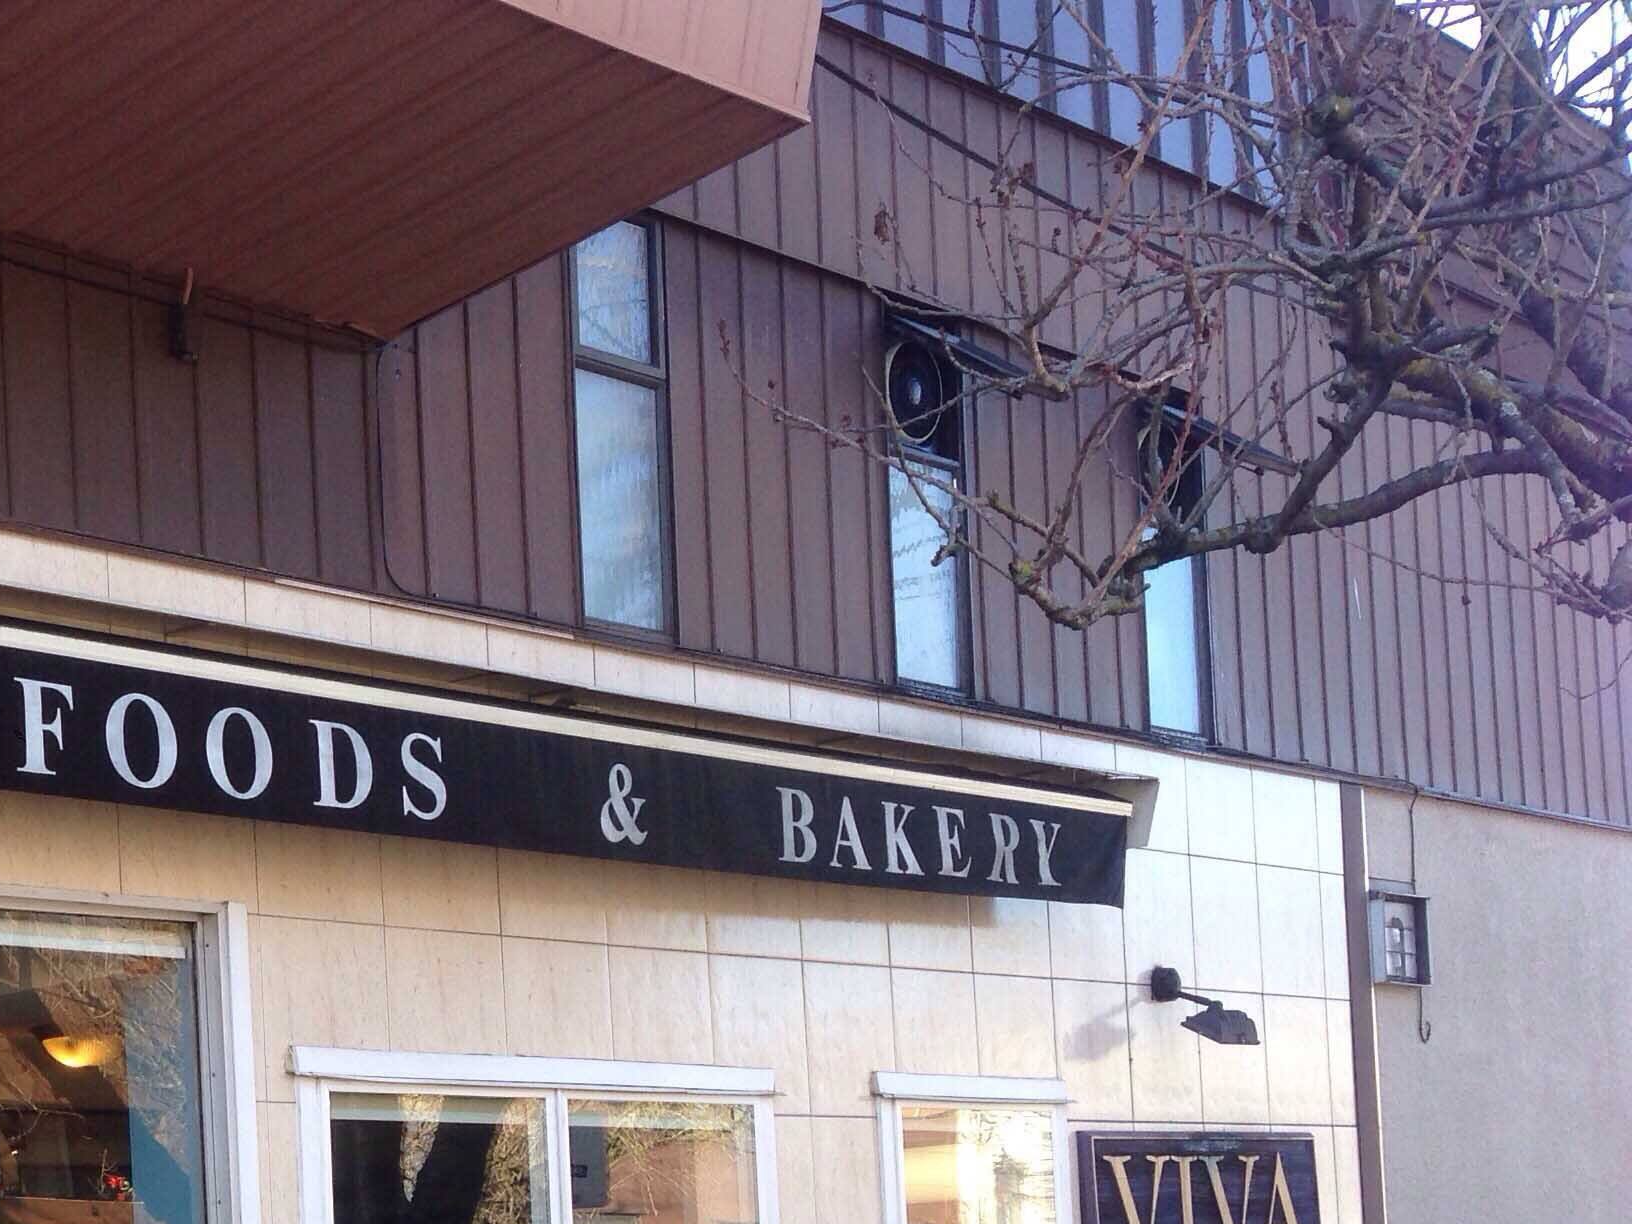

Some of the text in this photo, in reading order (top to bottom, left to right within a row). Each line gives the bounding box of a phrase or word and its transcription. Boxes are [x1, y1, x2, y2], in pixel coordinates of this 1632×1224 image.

[13, 676, 447, 820] FOODS
[600, 763, 648, 846] &
[775, 786, 1062, 887] BAKERY
